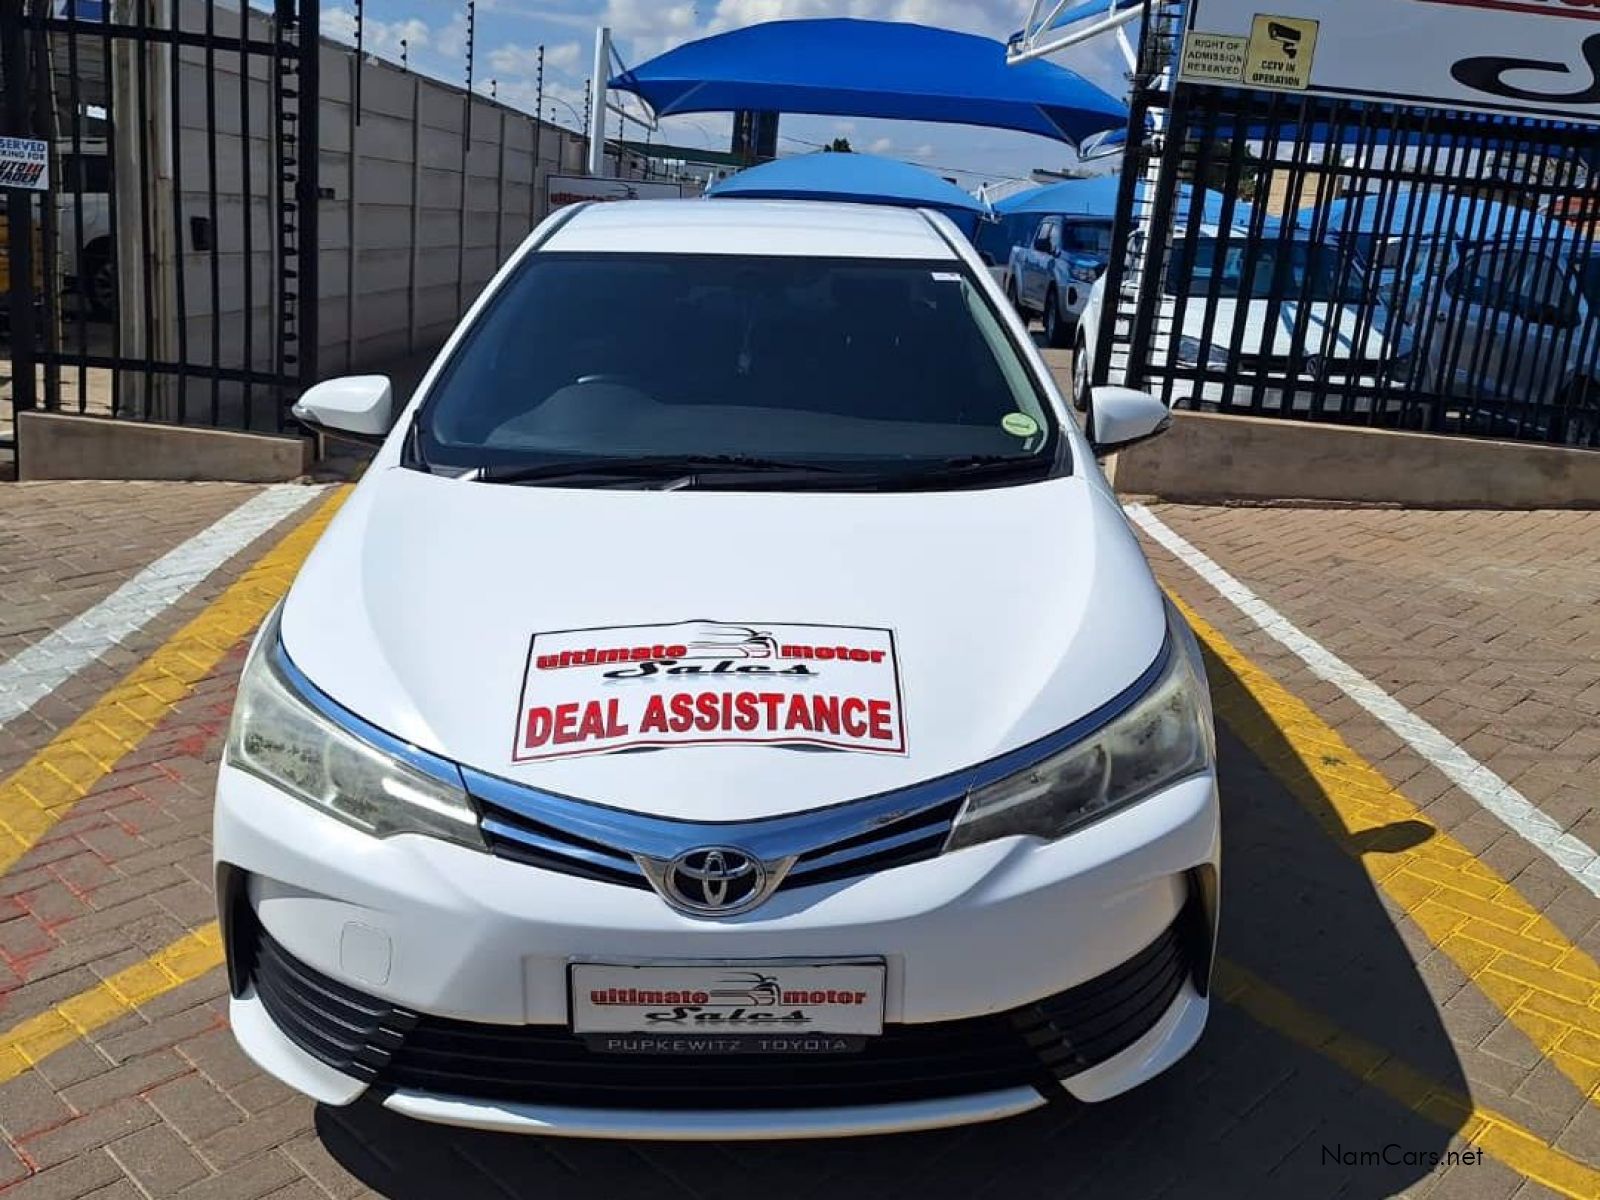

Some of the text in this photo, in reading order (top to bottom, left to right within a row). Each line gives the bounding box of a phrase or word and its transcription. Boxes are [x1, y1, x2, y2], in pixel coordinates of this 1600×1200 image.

[1195, 39, 1240, 51] RIGHT OF
[1187, 51, 1242, 63] ADMISSION
[1187, 62, 1239, 75] RESERVED
[1261, 60, 1296, 73] CCTV IN
[1252, 73, 1300, 86] OPERATION
[536, 643, 887, 671] ultimate motor
[602, 660, 820, 679] Sales
[525, 692, 893, 748] DEAL ASSISTANCE
[591, 988, 867, 1005] ultimate motor
[645, 1007, 814, 1023] Sales
[607, 1039, 848, 1051] PUPKEWITZ TOYOTA
